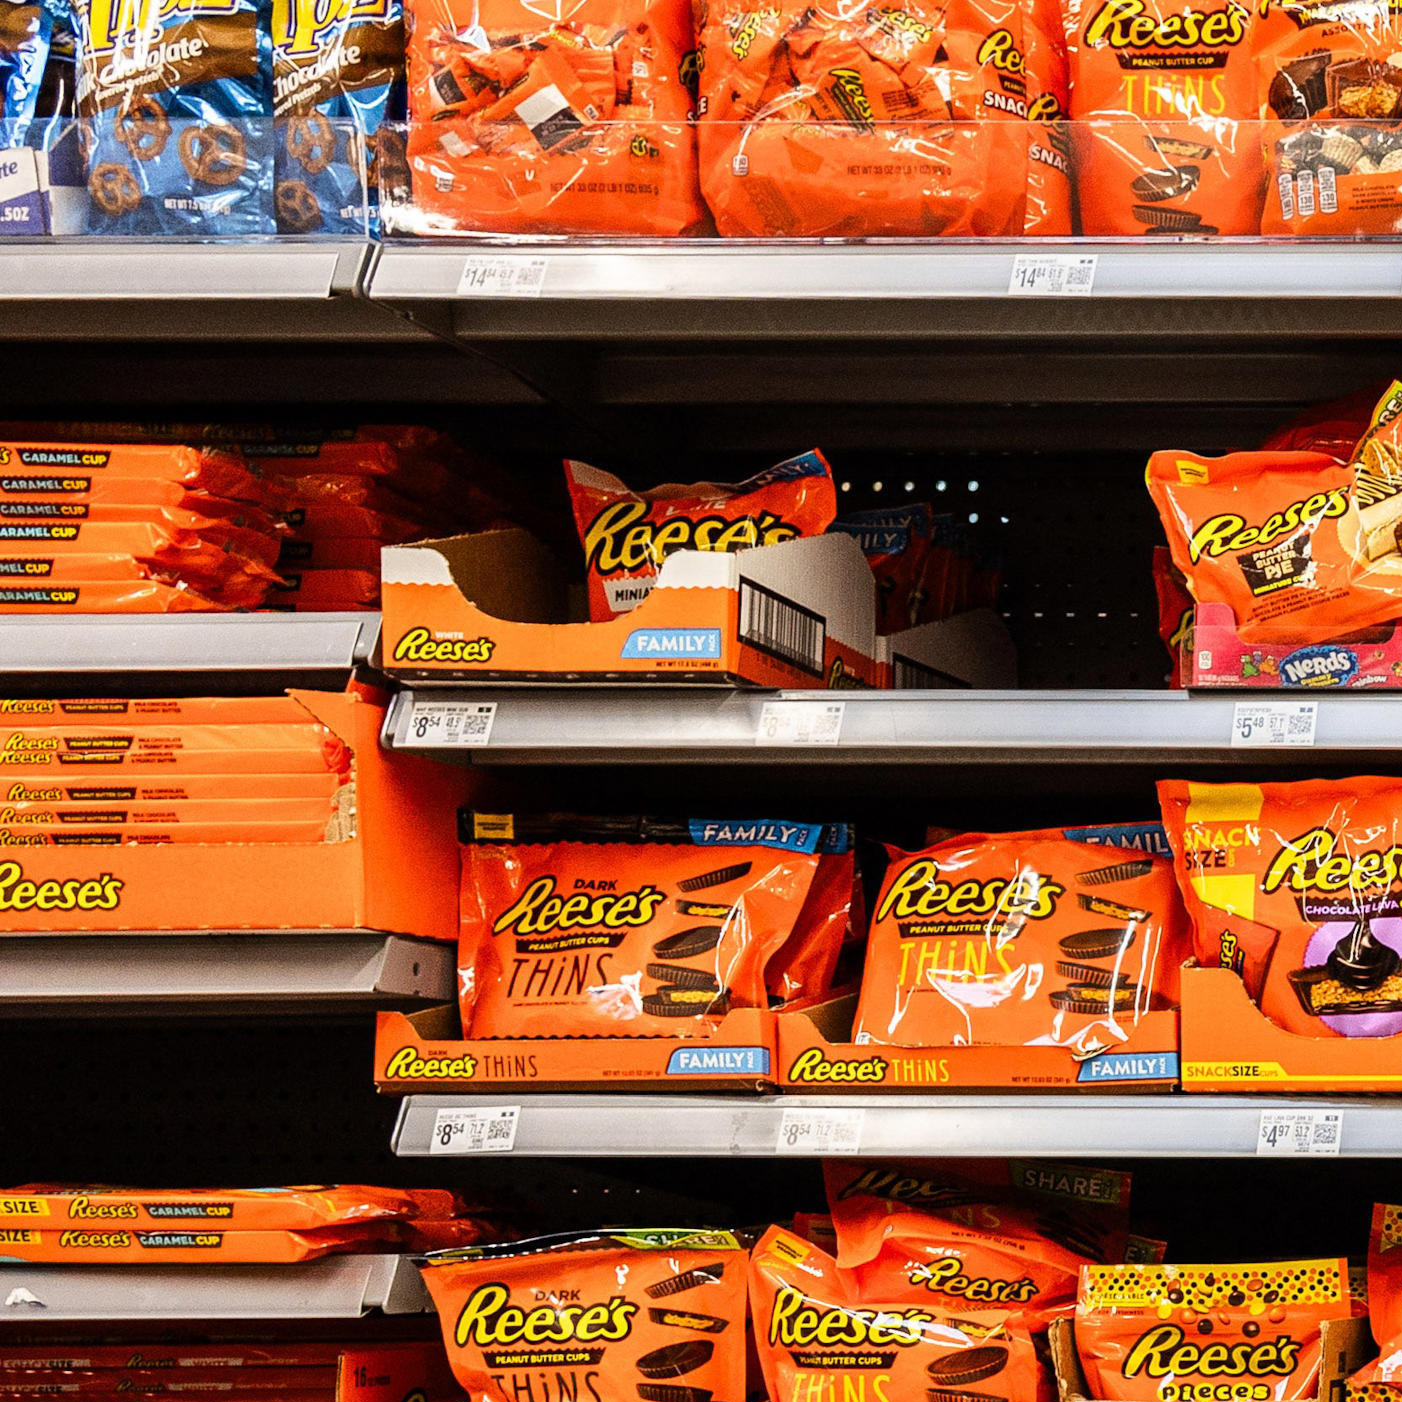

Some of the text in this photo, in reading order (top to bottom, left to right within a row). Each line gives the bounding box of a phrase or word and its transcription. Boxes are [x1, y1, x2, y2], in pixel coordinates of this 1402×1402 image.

[1086, 0, 1251, 49] Reese's
[1132, 56, 1214, 67] PEANUT BUTTER CUP
[21, 452, 107, 466] CARAMEL CUP
[1191, 488, 1350, 558] Reese's
[1252, 544, 1295, 560] PEANUT
[1255, 553, 1294, 570] BUTTER
[394, 627, 493, 663] Reese's
[636, 634, 704, 652] FAMILY
[5, 733, 58, 751] Reese's
[702, 823, 795, 844] FAMILY
[1185, 849, 1226, 869] SIZE
[574, 878, 618, 891] DARK
[494, 876, 666, 934] Reese's
[1306, 904, 1370, 916] CHOCOLATE
[1371, 900, 1398, 910] LAVA
[679, 1051, 744, 1068] FAMILY
[70, 1196, 230, 1219] Reese's CARAMEL CUP
[456, 1284, 636, 1347] Reese's
[496, 1352, 589, 1365] PEANUT BUTTER CUPS
